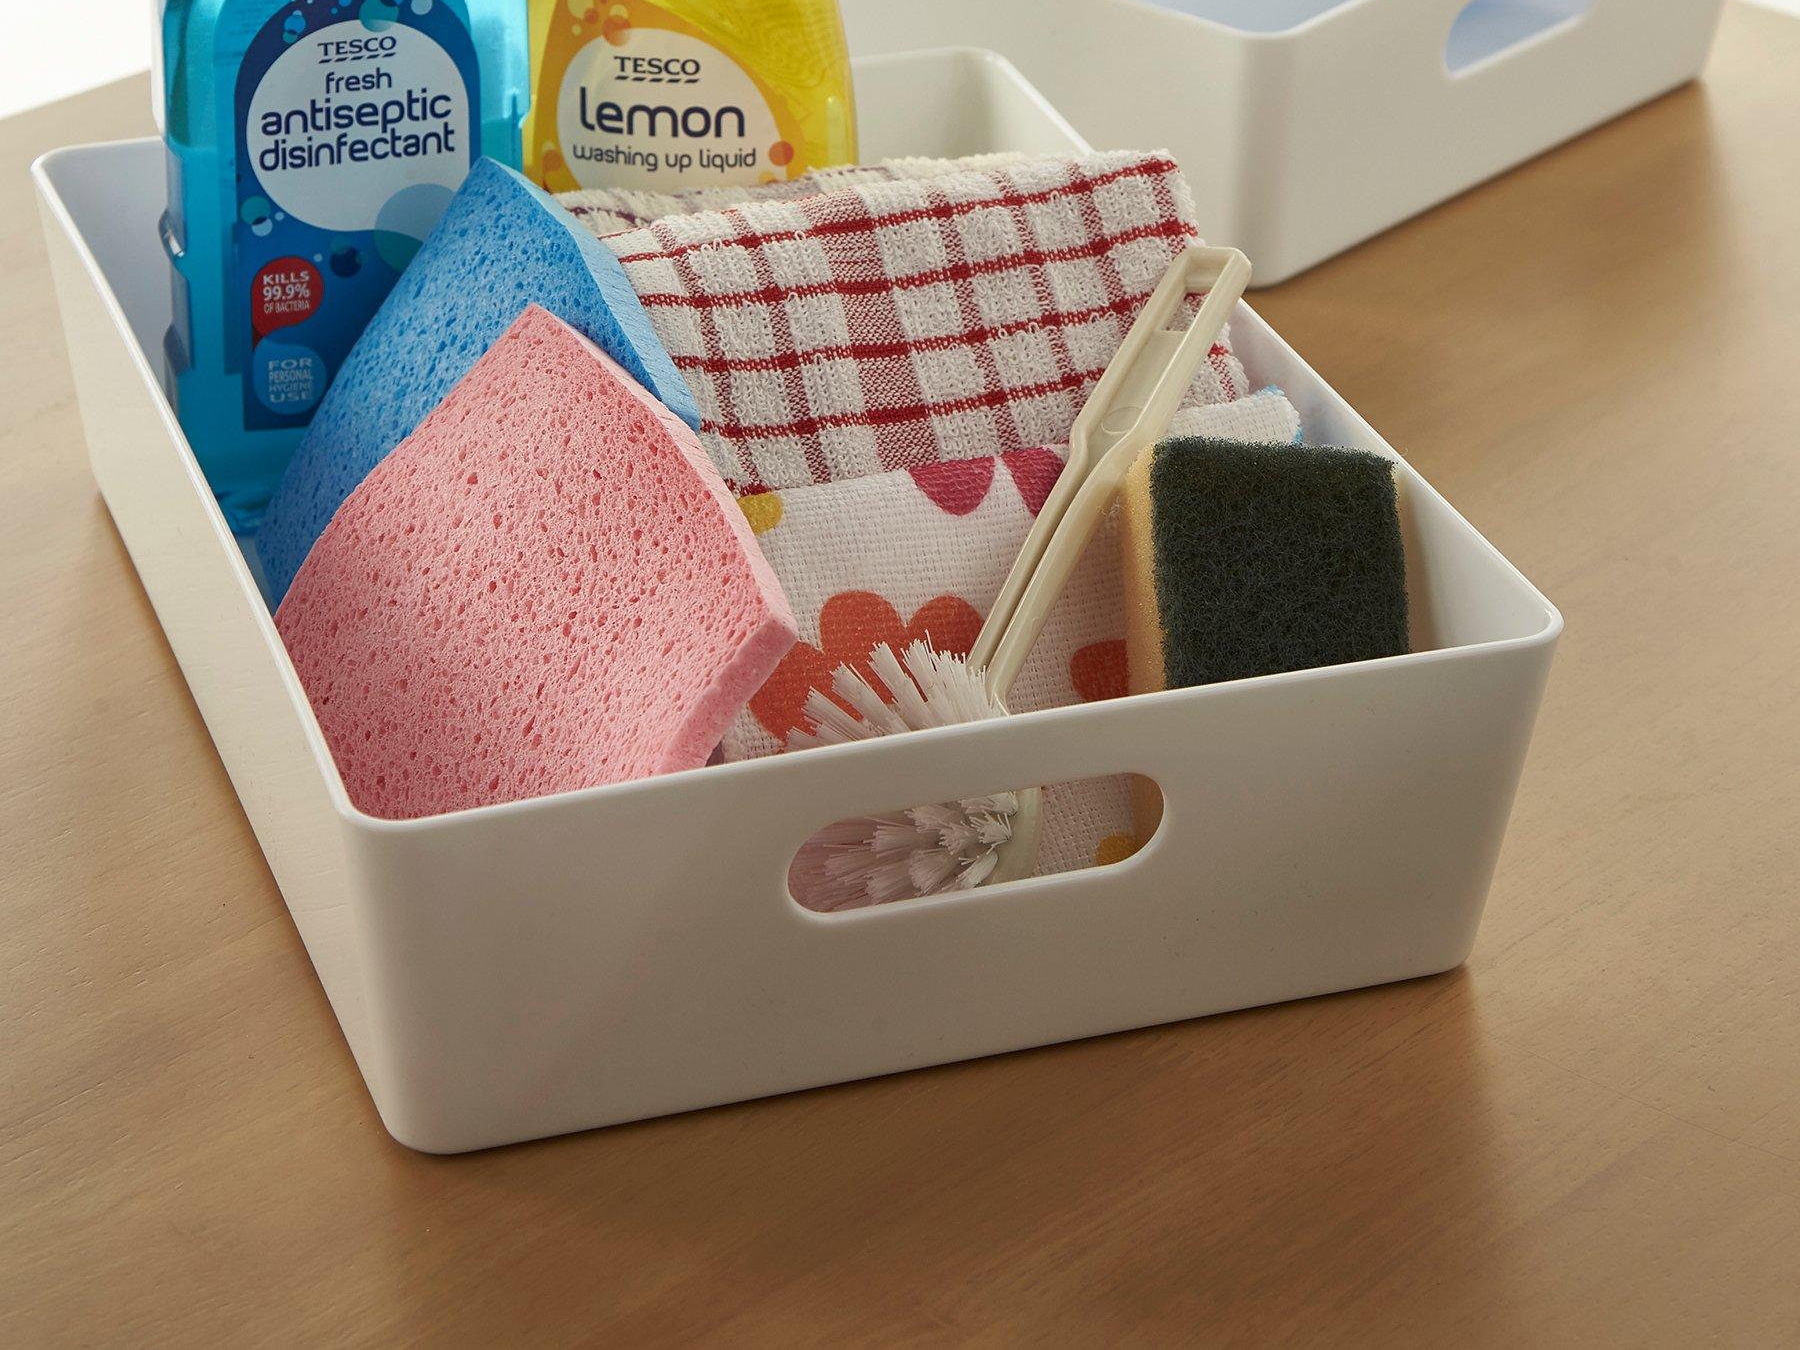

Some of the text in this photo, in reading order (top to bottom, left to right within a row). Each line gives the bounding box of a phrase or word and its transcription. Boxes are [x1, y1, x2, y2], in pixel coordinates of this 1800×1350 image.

[317, 36, 397, 56] TESCO
[614, 56, 701, 75] TESCO
[325, 67, 392, 94] fresh
[260, 87, 452, 136] antiseptic
[579, 86, 746, 138] lemon
[259, 121, 455, 171] disinfectant
[573, 144, 757, 173] washing up liquid
[263, 270, 310, 285] KILLS
[263, 283, 310, 301] 99.9%
[264, 300, 310, 314] OF BACTERIA
[268, 358, 313, 370] FOR
[268, 370, 313, 383] PERSONAL
[270, 392, 312, 403] USE
